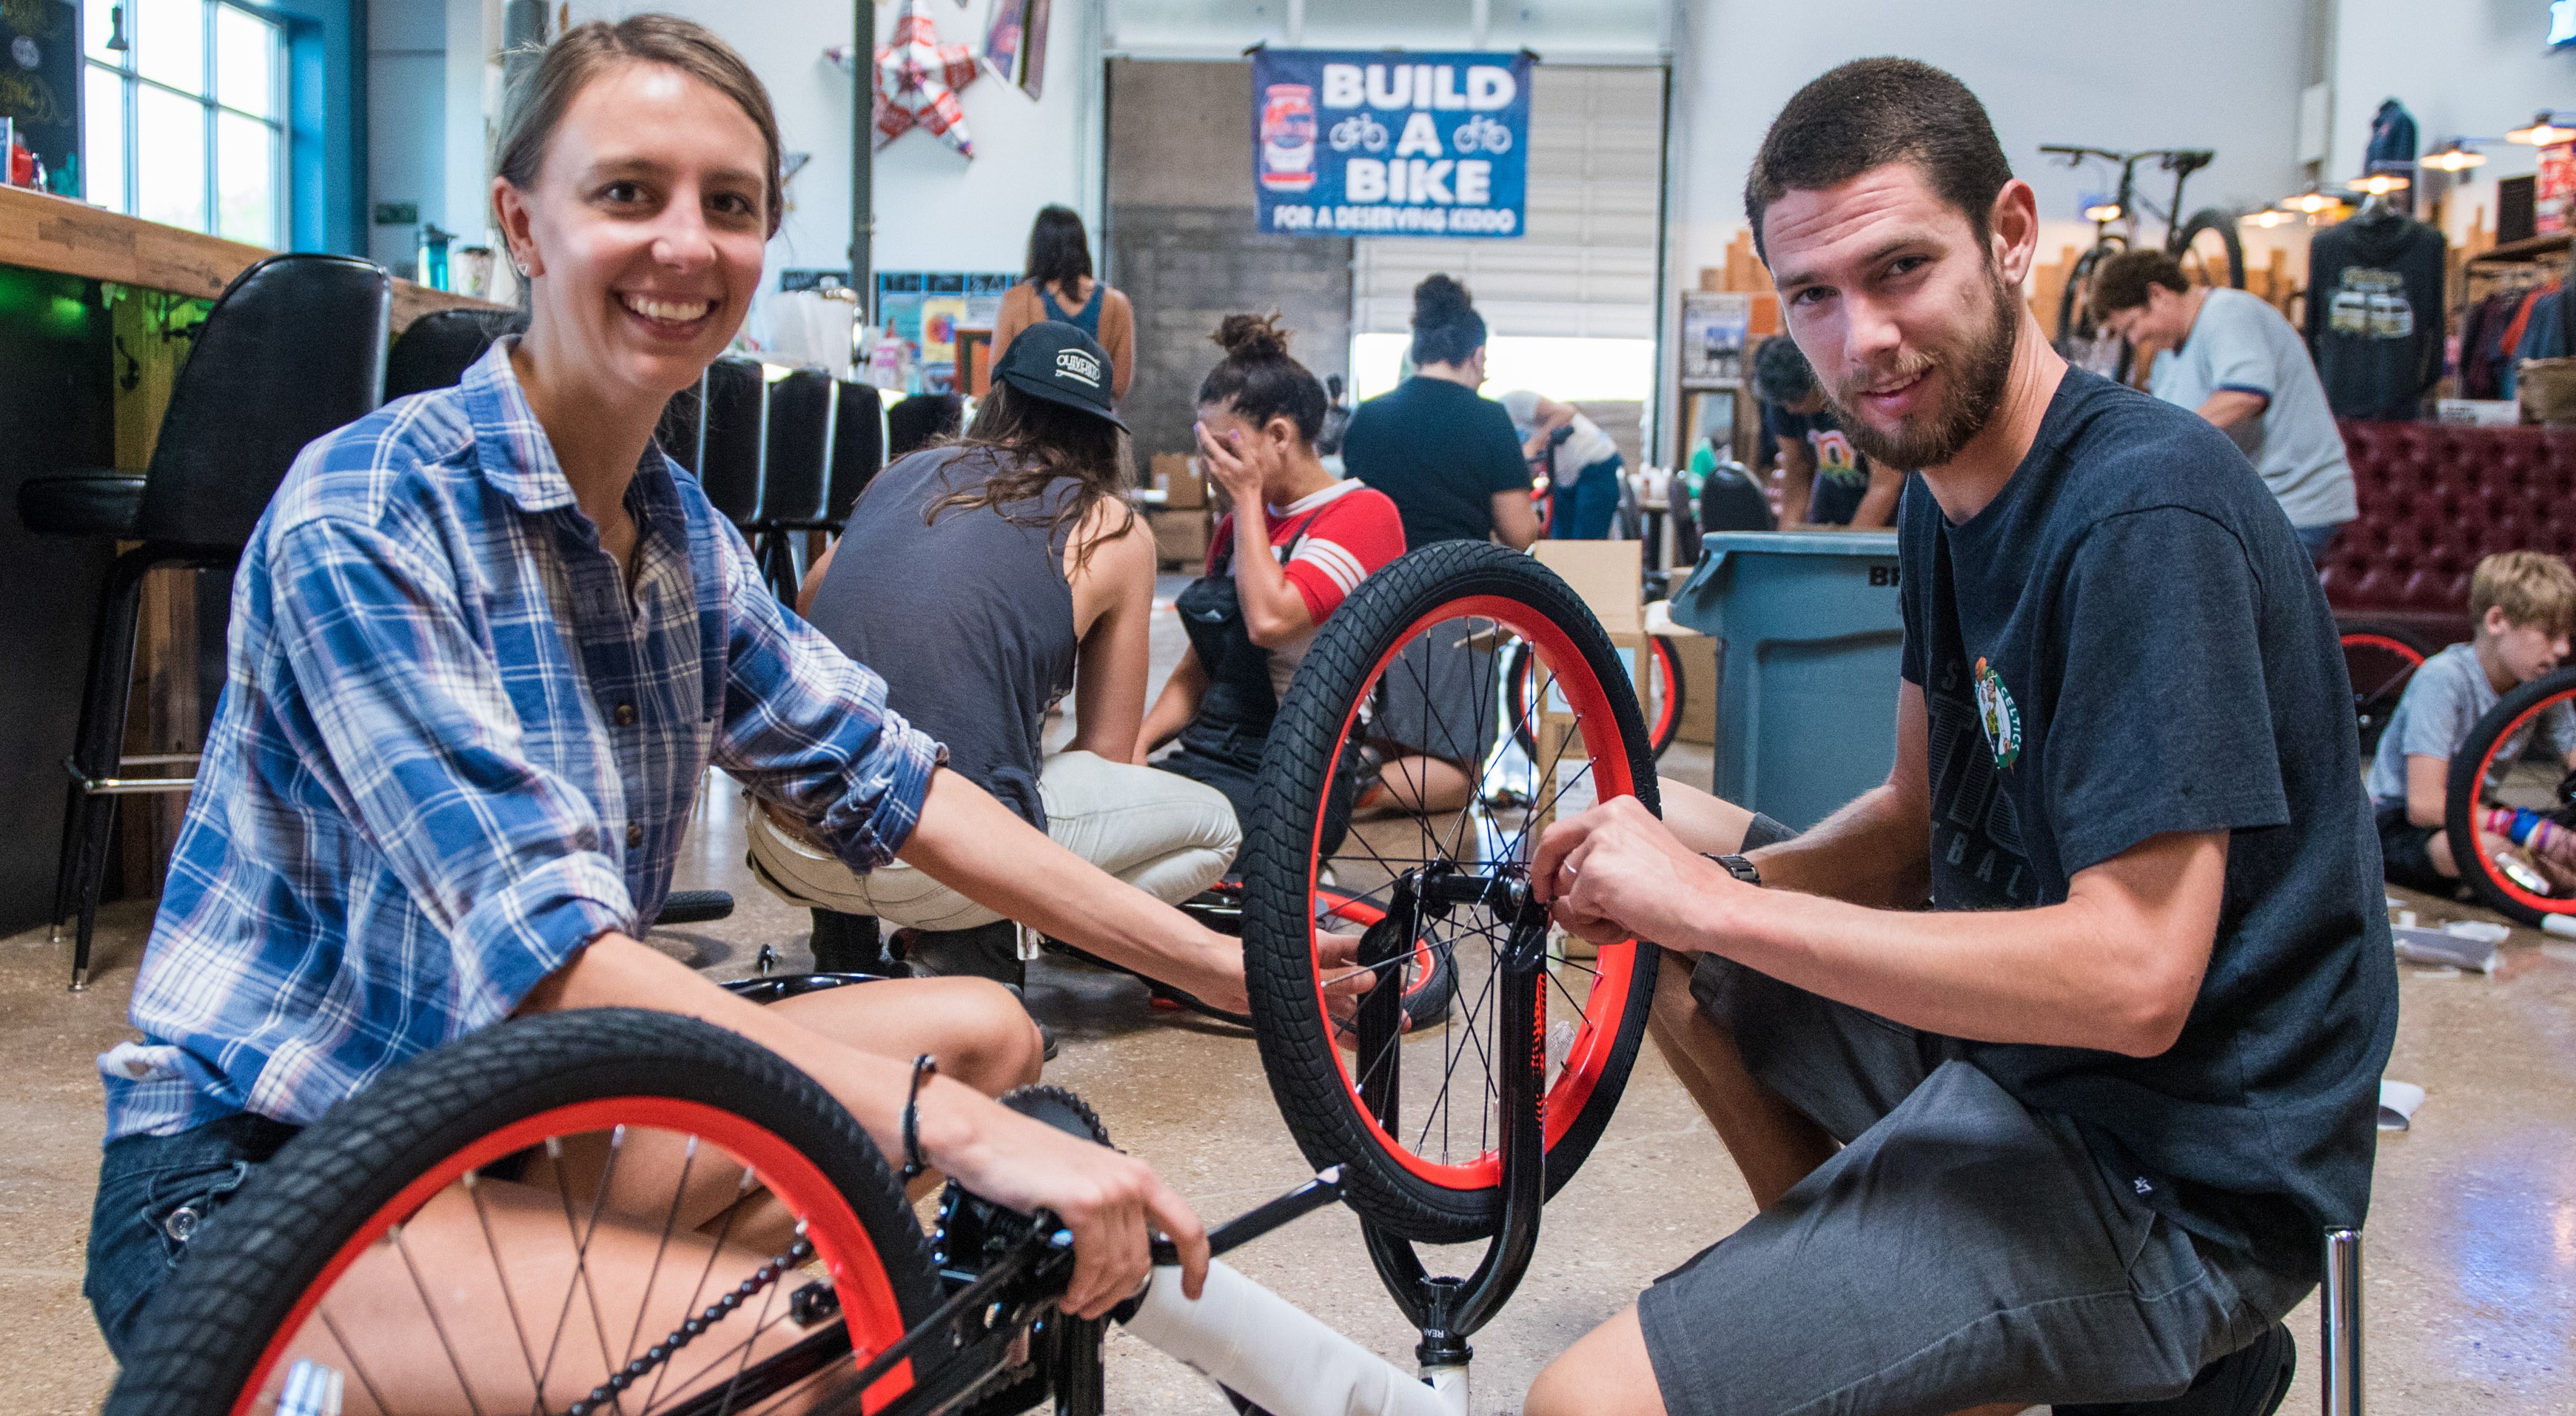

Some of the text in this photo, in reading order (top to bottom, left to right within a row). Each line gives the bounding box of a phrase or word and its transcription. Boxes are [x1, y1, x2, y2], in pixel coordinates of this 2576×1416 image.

[1323, 64, 1515, 110] BUILD
[1395, 112, 1443, 158] A
[1346, 158, 1492, 205] BIKE
[1272, 205, 1516, 233] FOR A DESERVING KIDDO
[2001, 687, 2022, 751] CELTICS
[1423, 1328, 1444, 1338] REAR
